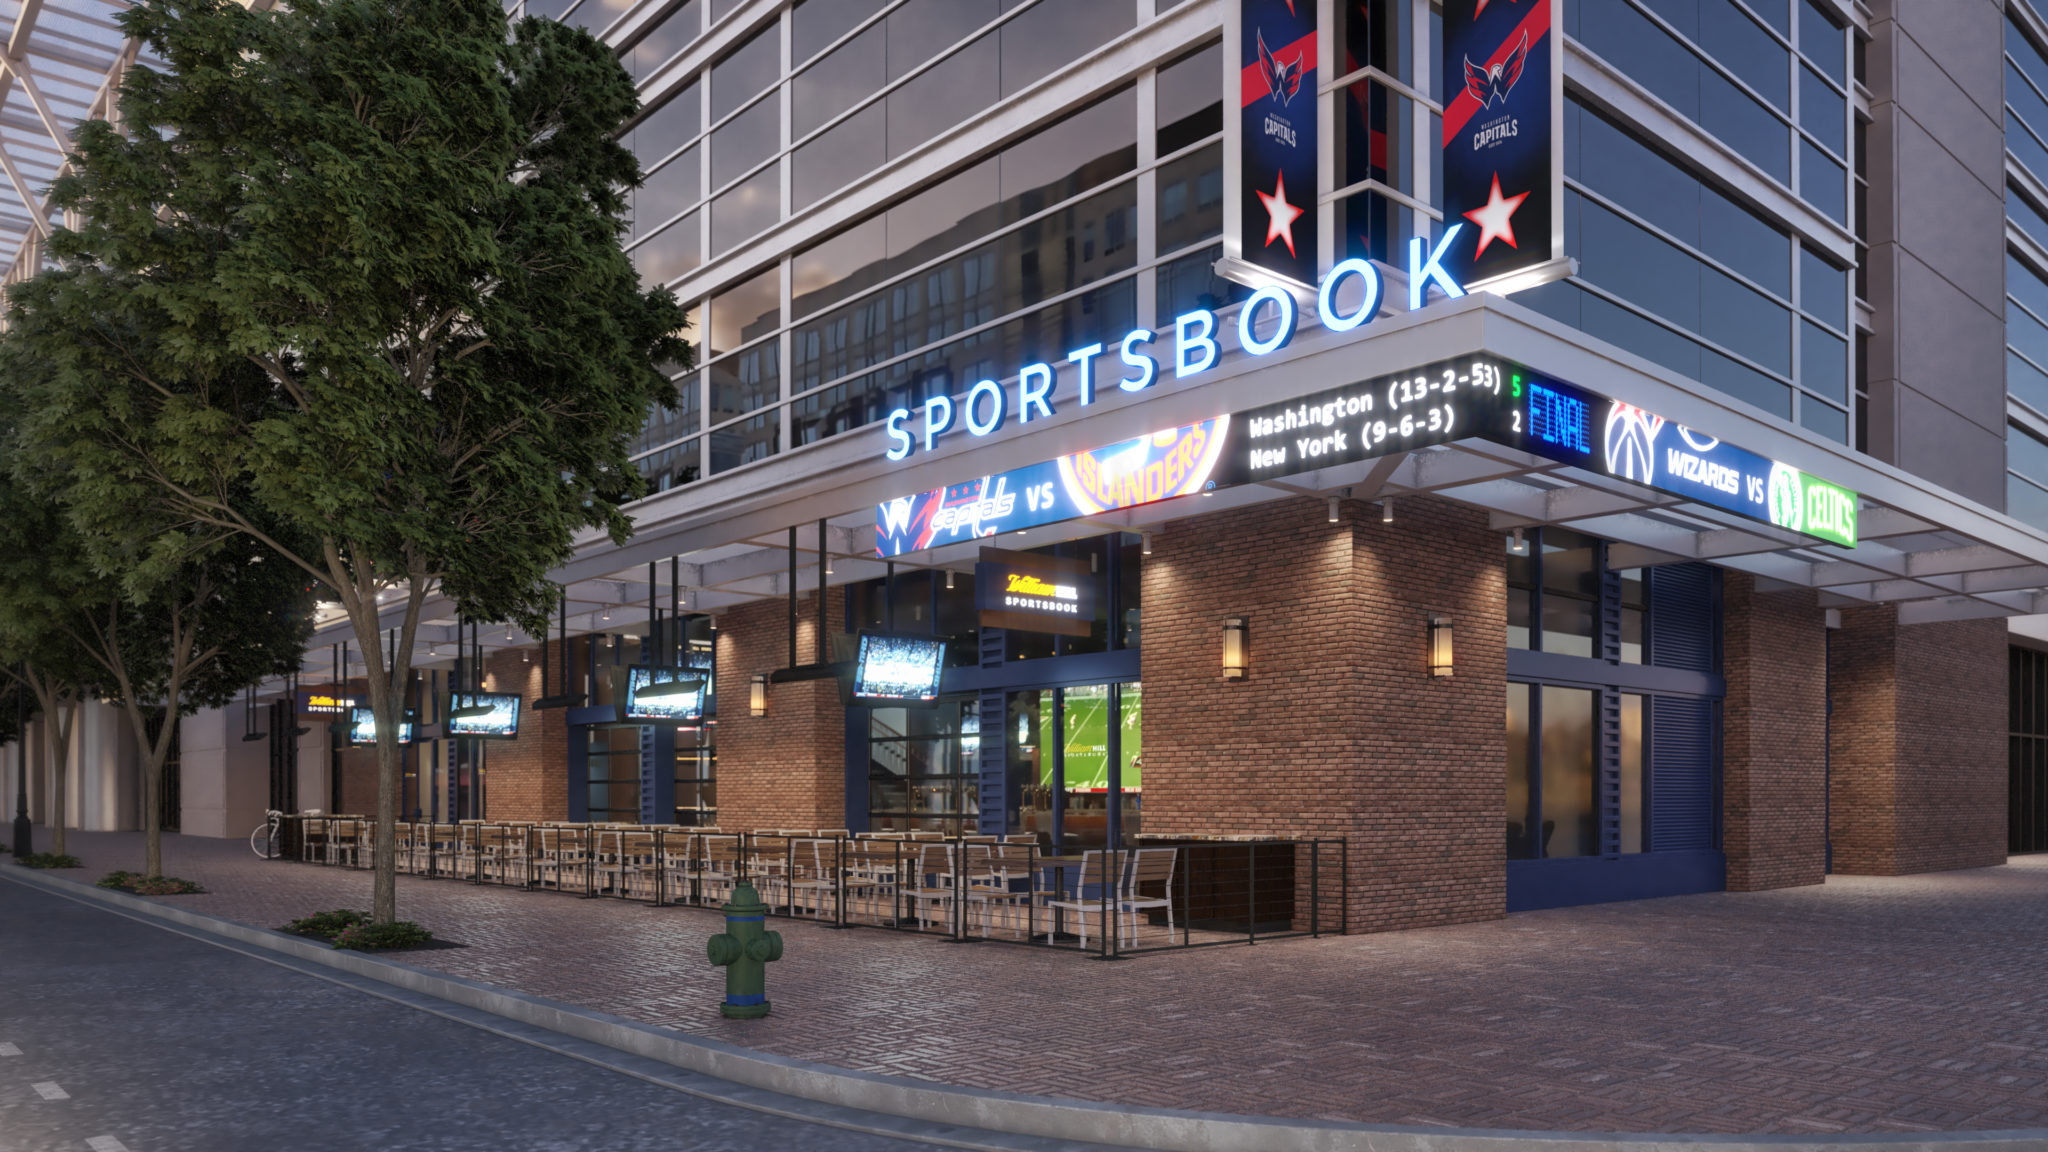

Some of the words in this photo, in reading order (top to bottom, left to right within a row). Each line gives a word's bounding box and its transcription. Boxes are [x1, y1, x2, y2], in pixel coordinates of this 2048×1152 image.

[1264, 116, 1297, 148] CAPITALS
[1473, 119, 1518, 151] CAPITALS
[884, 222, 1468, 462] SPORTSBOOK
[1249, 392, 1373, 439] Washington
[1388, 362, 1501, 411] (13-2-53)
[1512, 375, 1521, 398] 5
[1528, 382, 1591, 455] FINAL
[1075, 423, 1207, 507] ISLANDERS
[1249, 446, 1287, 470] New
[1296, 430, 1348, 461] York
[1361, 404, 1455, 450] (9-6-3)
[1512, 410, 1522, 433] 2
[1026, 481, 1055, 512] VS
[1667, 447, 1740, 495] WIZARDS
[1746, 474, 1764, 505] VS
[1807, 484, 1855, 543] CELTICS
[1005, 596, 1078, 613] SPORTSBOOK
